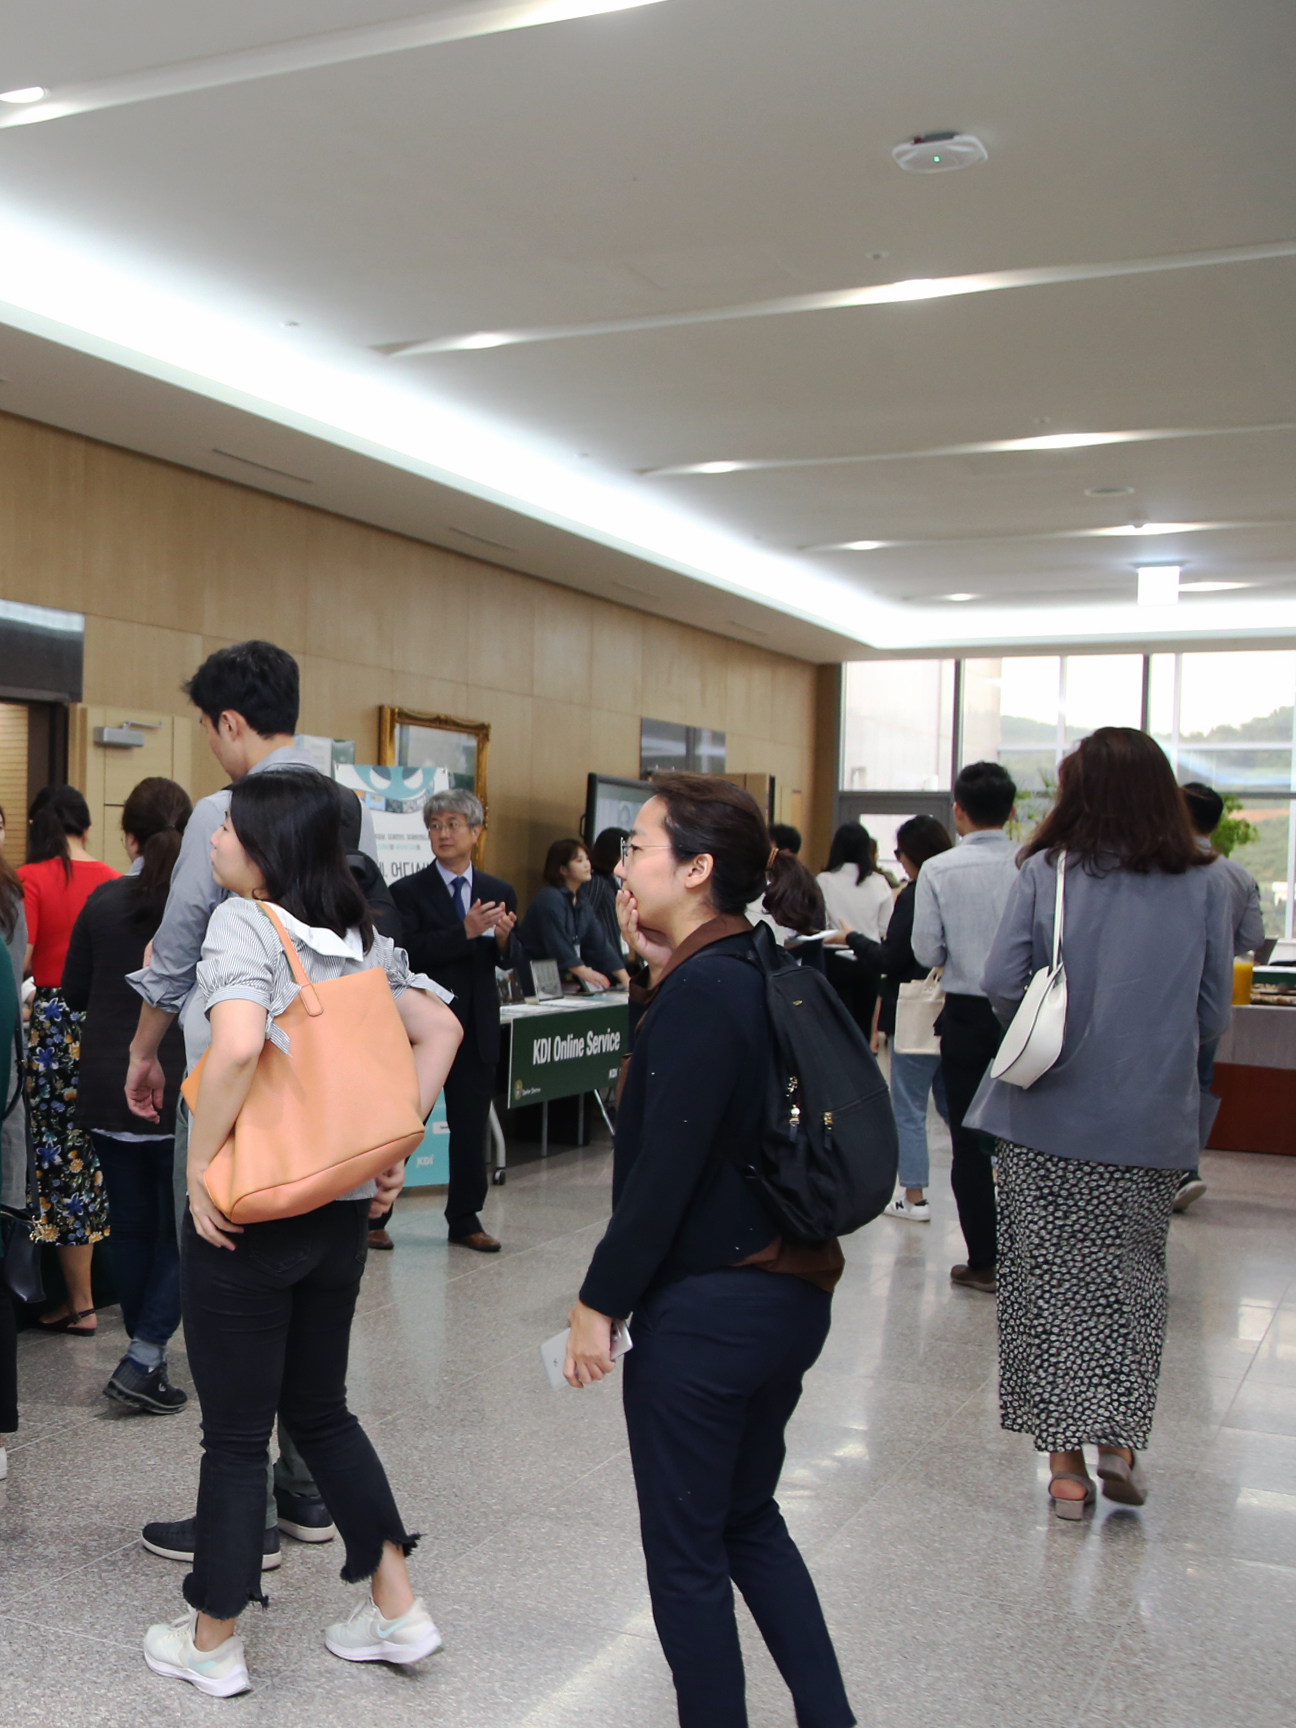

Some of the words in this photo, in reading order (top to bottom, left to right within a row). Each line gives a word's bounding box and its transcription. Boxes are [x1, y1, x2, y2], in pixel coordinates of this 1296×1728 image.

[532, 1036, 551, 1065] KDI
[553, 1033, 584, 1062] Online
[586, 1028, 621, 1055] Service
